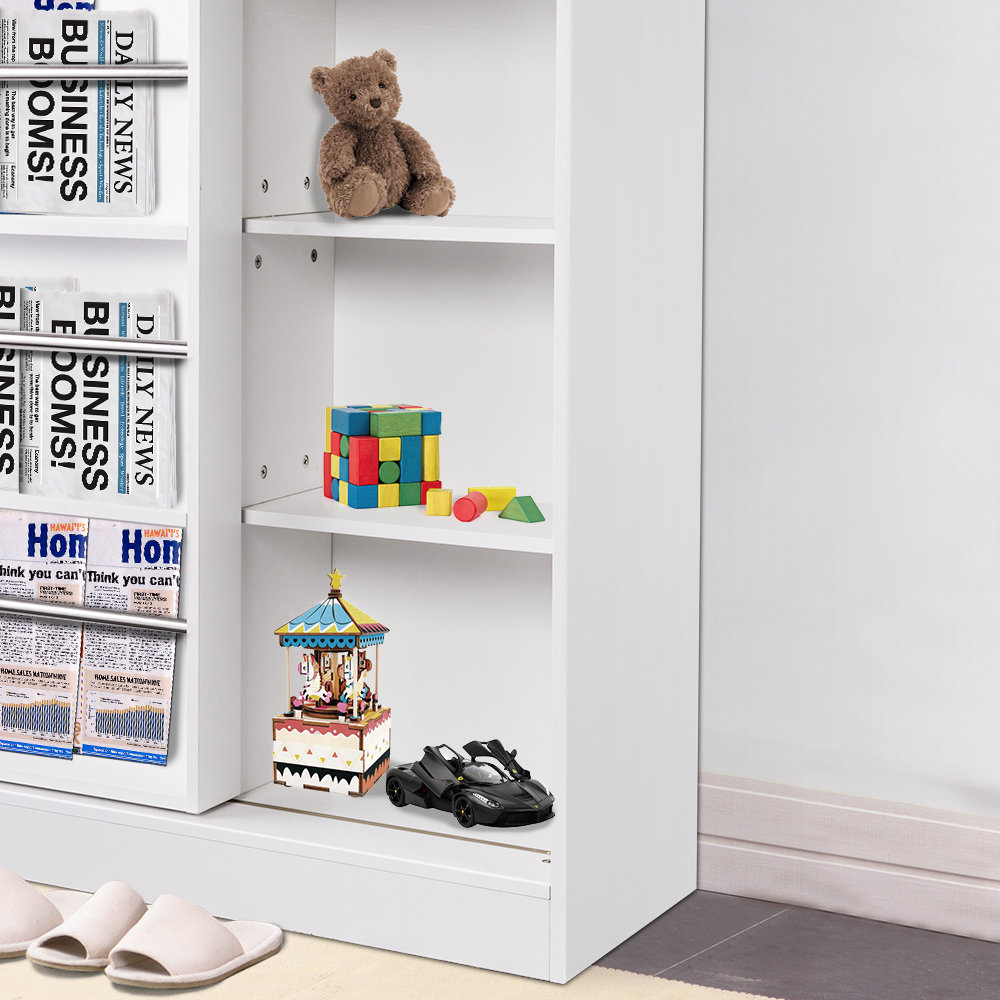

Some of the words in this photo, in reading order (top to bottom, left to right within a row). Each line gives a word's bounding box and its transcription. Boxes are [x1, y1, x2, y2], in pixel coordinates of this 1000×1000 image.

[114, 31, 134, 111] DALY
[114, 117, 134, 194] NEWS
[135, 314, 155, 399] DILY
[135, 406, 155, 485] NEWS
[28, 570, 51, 581] you
[87, 571, 119, 584] Think
[123, 576, 145, 587] you
[0, 668, 16, 676] HOME
[17, 669, 32, 677] SALES
